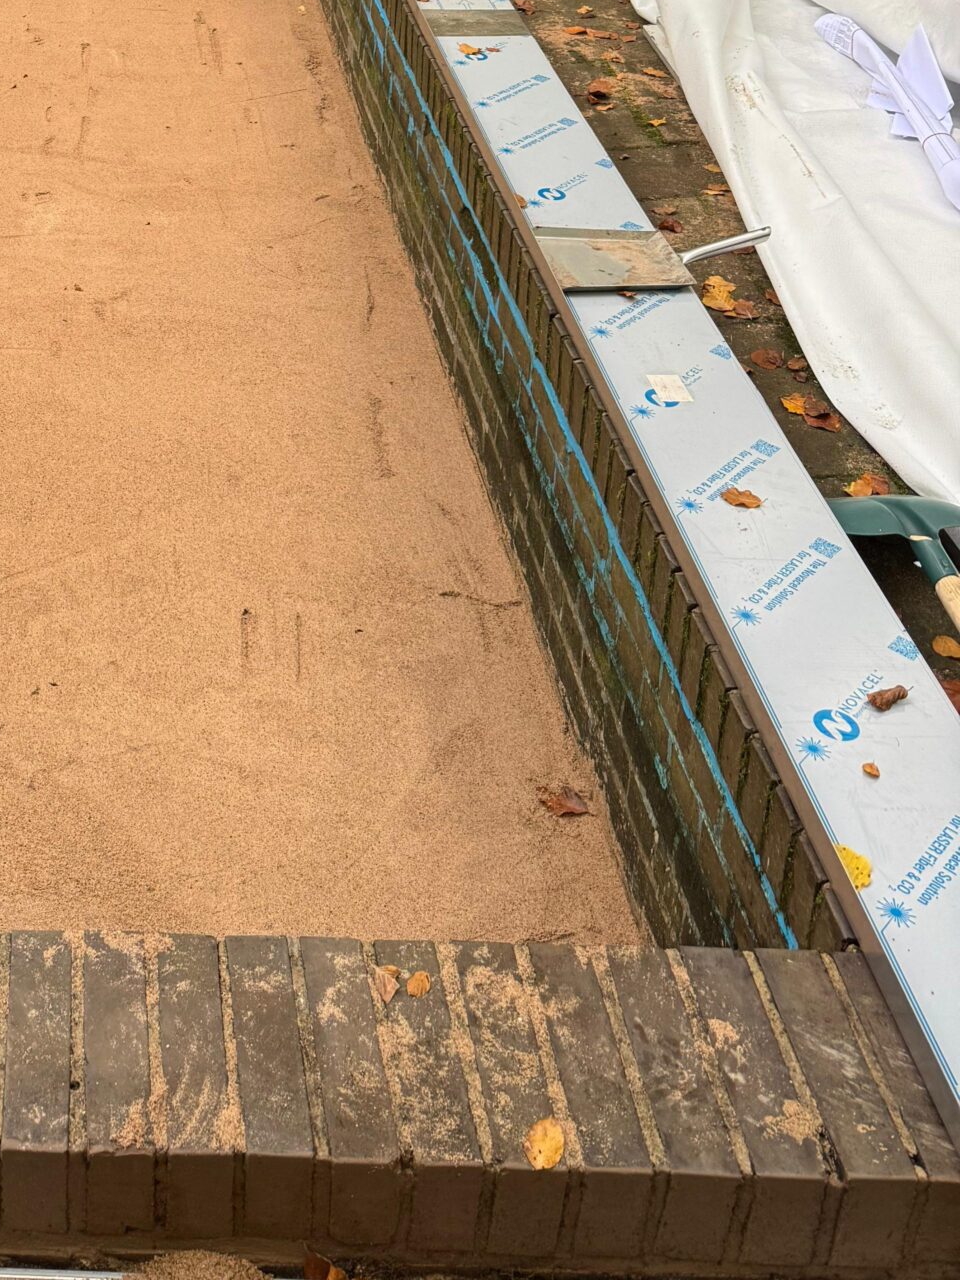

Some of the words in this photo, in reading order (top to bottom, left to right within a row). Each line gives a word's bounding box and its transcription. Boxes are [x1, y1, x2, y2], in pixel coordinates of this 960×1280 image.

[796, 550, 812, 560] for
[809, 558, 828, 569] The
[776, 557, 803, 578] LASER
[763, 574, 784, 590] Fiber
[788, 567, 816, 591] Novacel
[757, 587, 768, 596] &
[764, 587, 795, 611] Solution
[838, 672, 884, 714] NOVACEL
[928, 826, 959, 855] LASER
[912, 851, 937, 874] Fiber
[906, 871, 921, 882] &
[917, 871, 952, 906] Solution
